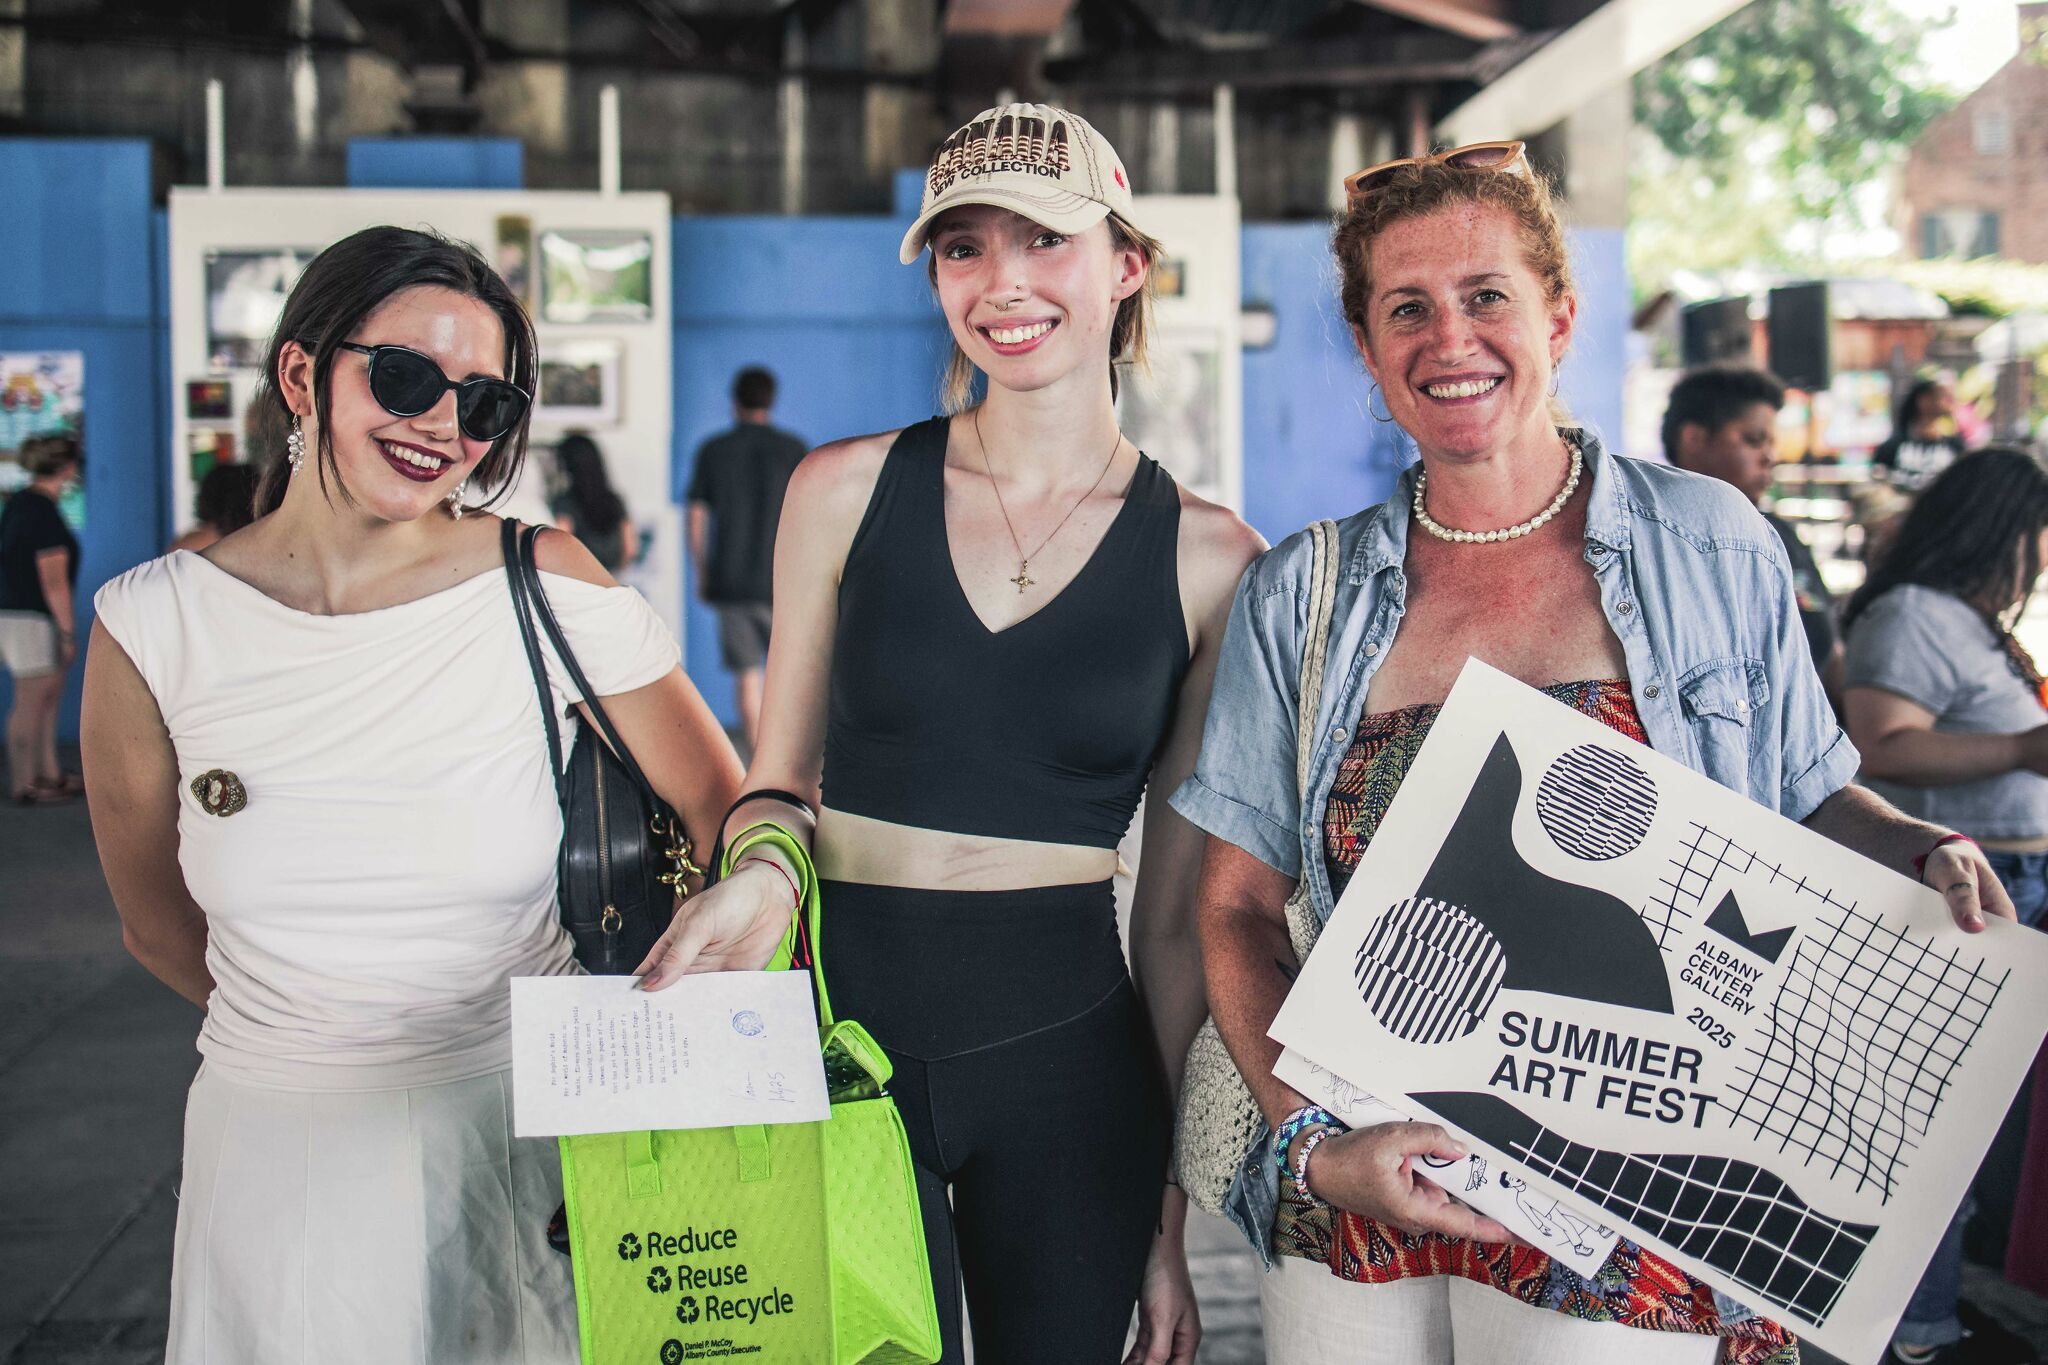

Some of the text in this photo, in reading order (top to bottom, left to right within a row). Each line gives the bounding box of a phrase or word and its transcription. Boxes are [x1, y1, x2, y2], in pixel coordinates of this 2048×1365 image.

[933, 161, 1061, 200] NEW COLLECTION
[1688, 955, 1753, 998] CENTER
[1696, 940, 1763, 983] ALBANY
[1680, 969, 1755, 1016] GALLERY
[1499, 1011, 1703, 1084] SUMMER
[1686, 1007, 1736, 1049] 2025
[1488, 1054, 1718, 1129] ART FEST
[647, 1227, 737, 1258] Reduce
[678, 1264, 748, 1290] Reuse
[706, 1286, 794, 1324] Recycle
[684, 1338, 733, 1351] Daniel P. McCoy
[685, 1345, 762, 1360] Albany County Executive
